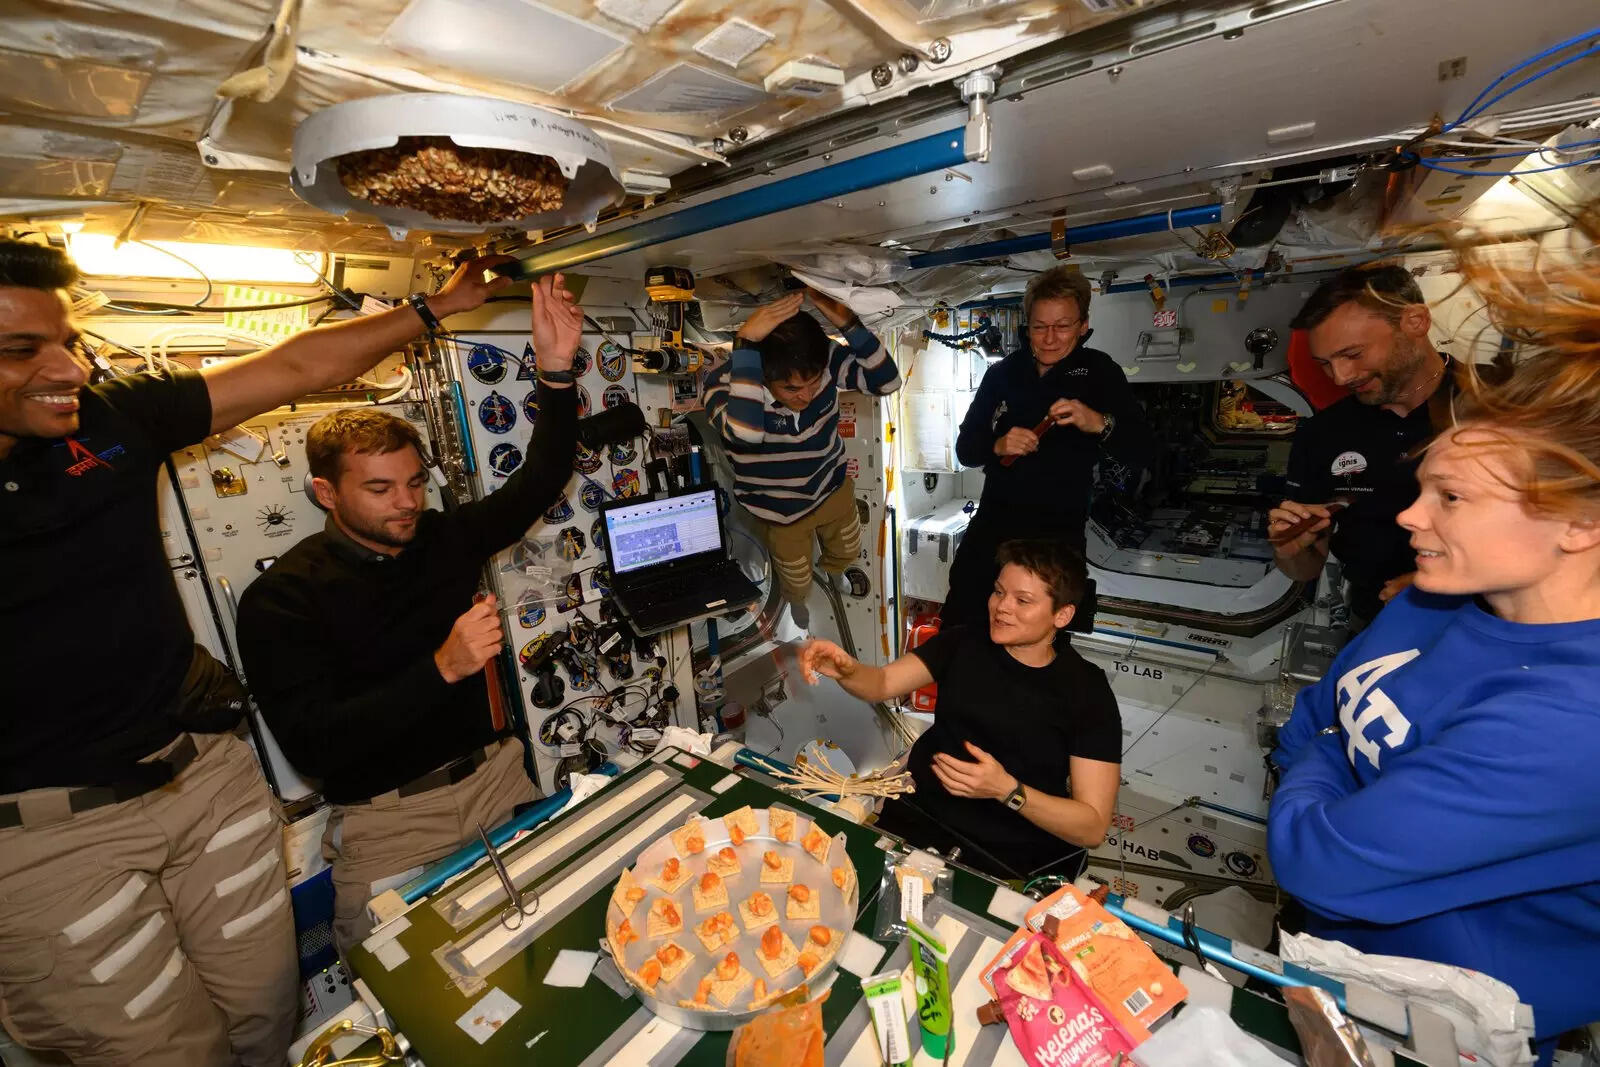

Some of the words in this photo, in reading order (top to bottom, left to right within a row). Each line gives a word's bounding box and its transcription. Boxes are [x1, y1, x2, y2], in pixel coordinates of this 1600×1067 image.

[1156, 313, 1173, 325] EXIT
[1338, 455, 1358, 468] ignis
[1133, 664, 1163, 680] LAB
[1122, 839, 1160, 861] HAB
[1034, 1003, 1104, 1067] Helena's
